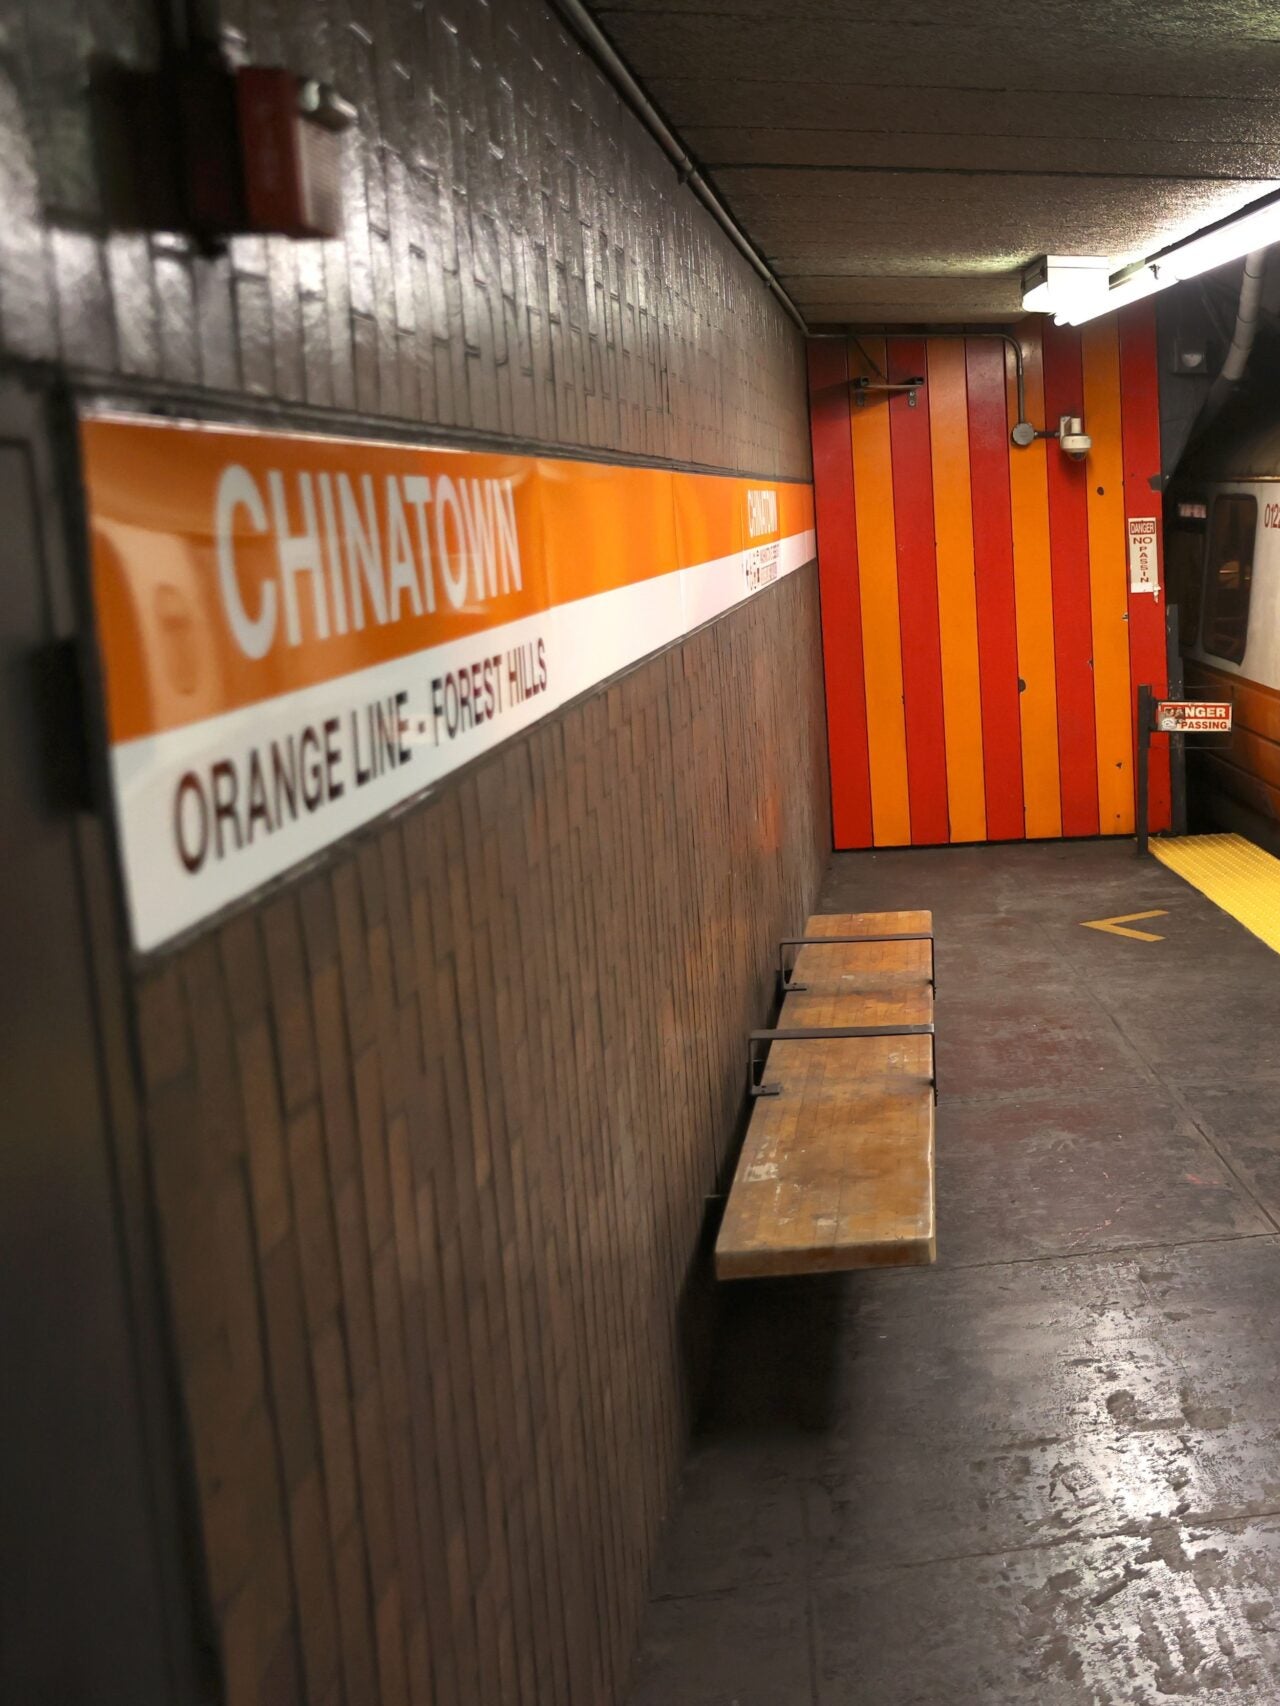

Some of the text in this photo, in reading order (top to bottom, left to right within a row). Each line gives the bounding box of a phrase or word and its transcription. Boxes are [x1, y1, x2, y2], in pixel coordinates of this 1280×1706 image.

[1131, 522, 1154, 534] DANGER
[1133, 536, 1153, 545] NO
[215, 463, 522, 660] CHINATOWN
[1181, 720, 1227, 730] PASSING
[174, 718, 344, 875] ORANGE
[351, 691, 412, 787] LINE
[431, 654, 504, 748] FOREST
[507, 637, 548, 708] HILLS
